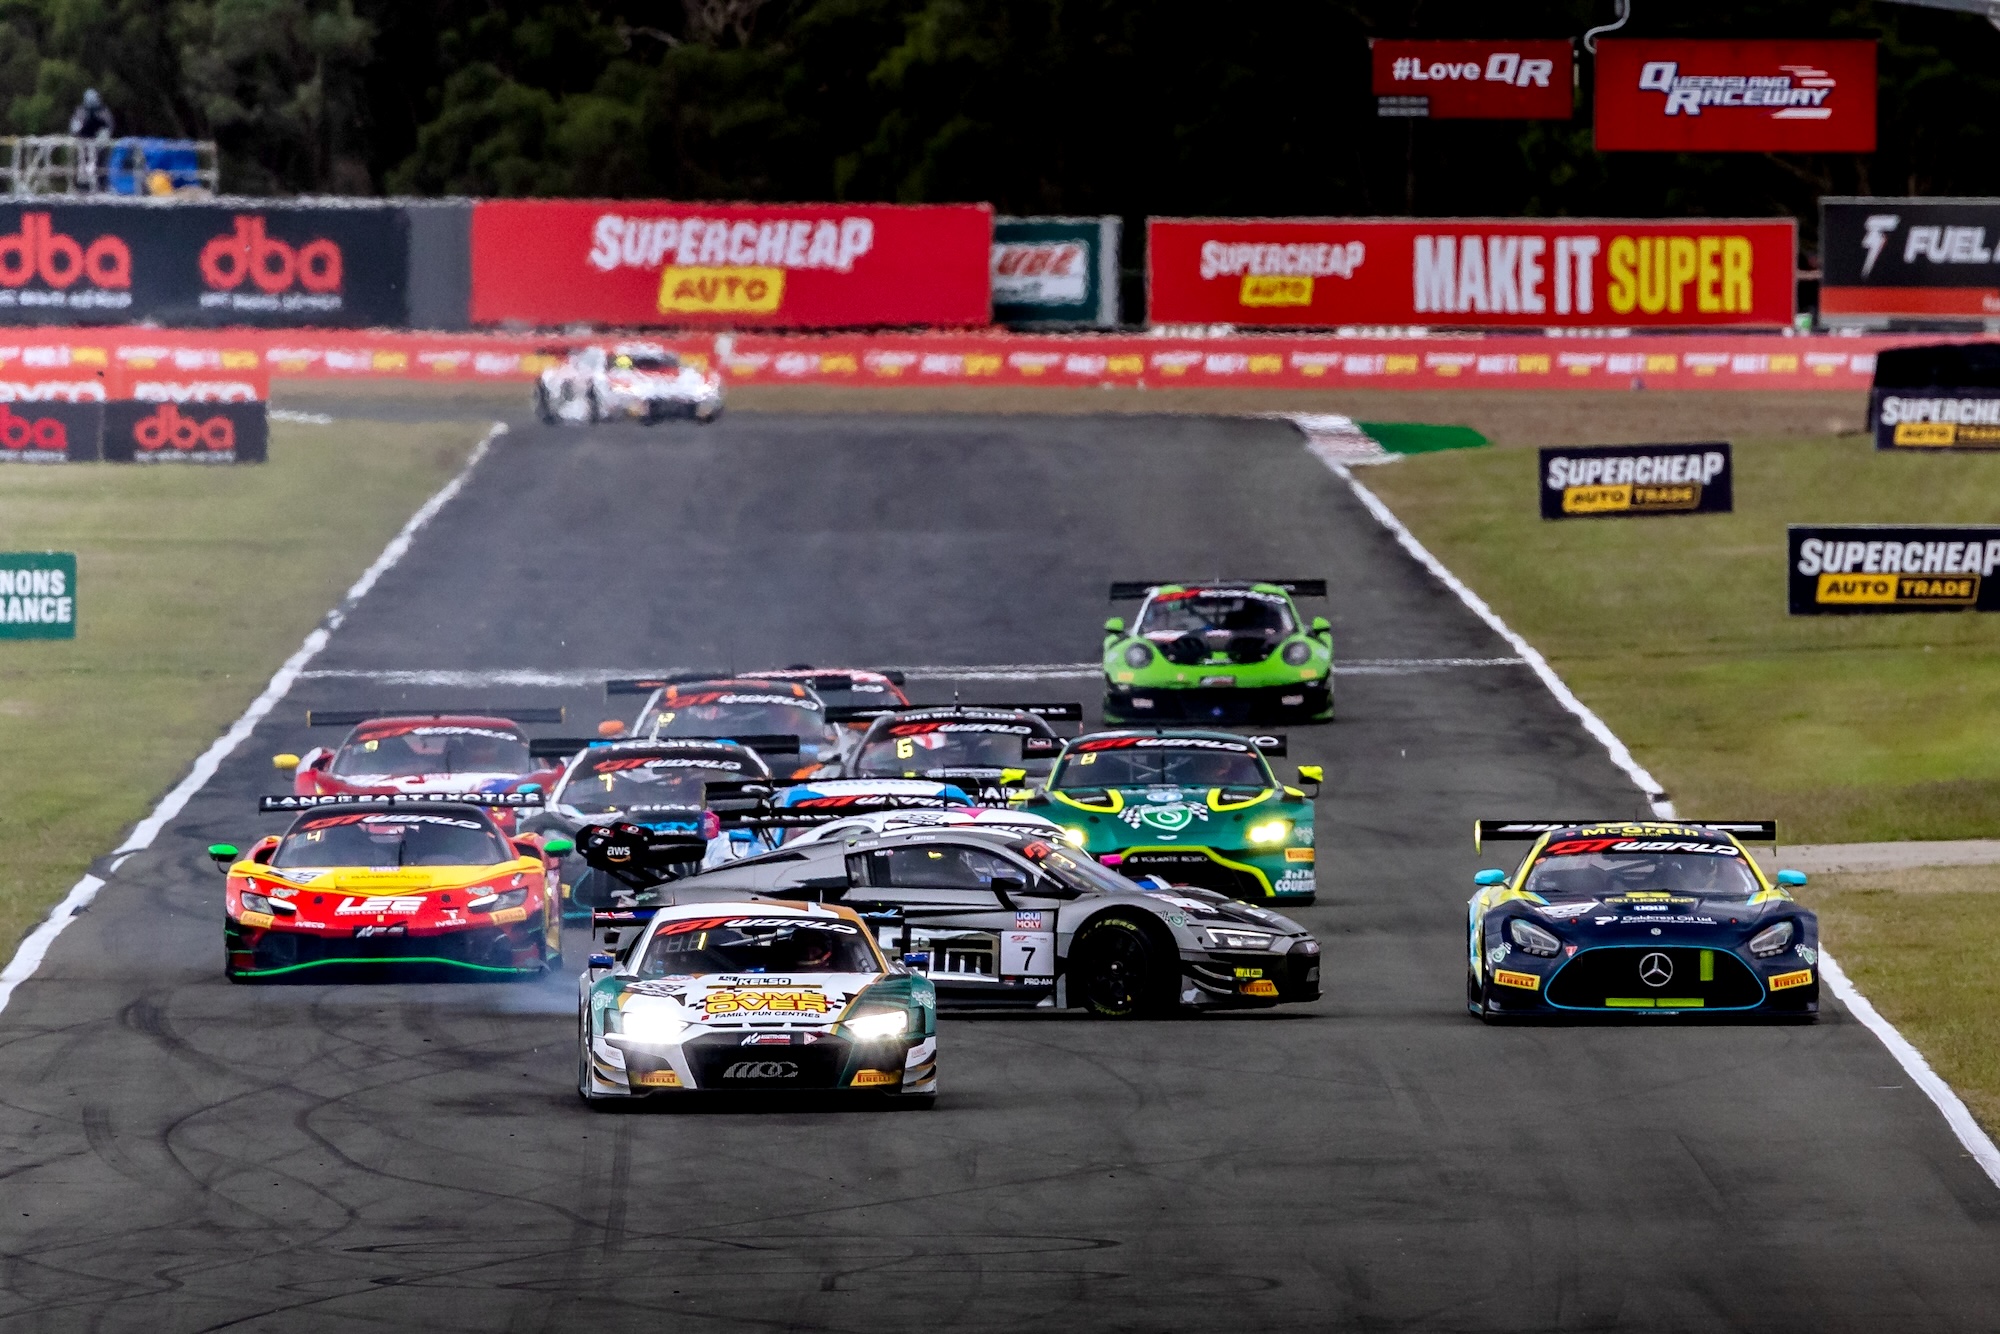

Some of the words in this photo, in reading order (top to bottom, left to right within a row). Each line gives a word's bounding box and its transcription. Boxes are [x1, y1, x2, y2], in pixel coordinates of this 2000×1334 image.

[1392, 57, 1481, 81] #Love
[1484, 53, 1553, 88] QR
[1664, 88, 1829, 116] RACEWAY
[0, 211, 132, 289] dba
[199, 214, 343, 294] dba
[589, 213, 874, 274] SUPERCHEAP
[1903, 225, 1991, 265] FUEL
[1200, 239, 1366, 281] SUPERCHEAP
[1413, 235, 1546, 315] MAKE
[1554, 235, 1600, 315] IT
[1607, 235, 1754, 315] SUPER
[673, 276, 770, 303] AUTO
[133, 403, 235, 451] dba
[1547, 452, 1725, 491] SUPERCHEAP
[1797, 538, 2000, 577] SUPERCHEAP
[1826, 579, 1891, 596] AUTO
[1901, 579, 1972, 597] TRADE
[1581, 826, 1700, 838] McGrath
[606, 846, 631, 856] aws
[1611, 841, 1740, 856] WORLD
[337, 897, 428, 911] LEE
[1016, 911, 1041, 920] LIQUI
[724, 918, 859, 935] WORLD
[1016, 920, 1041, 928] MOLY
[1021, 946, 1036, 971] 7
[737, 977, 791, 985] KELSO
[705, 999, 828, 1014] OVER
[706, 991, 827, 1001] GAME
[714, 1011, 750, 1019] FAMILY
[775, 1011, 821, 1019] CENTRES
